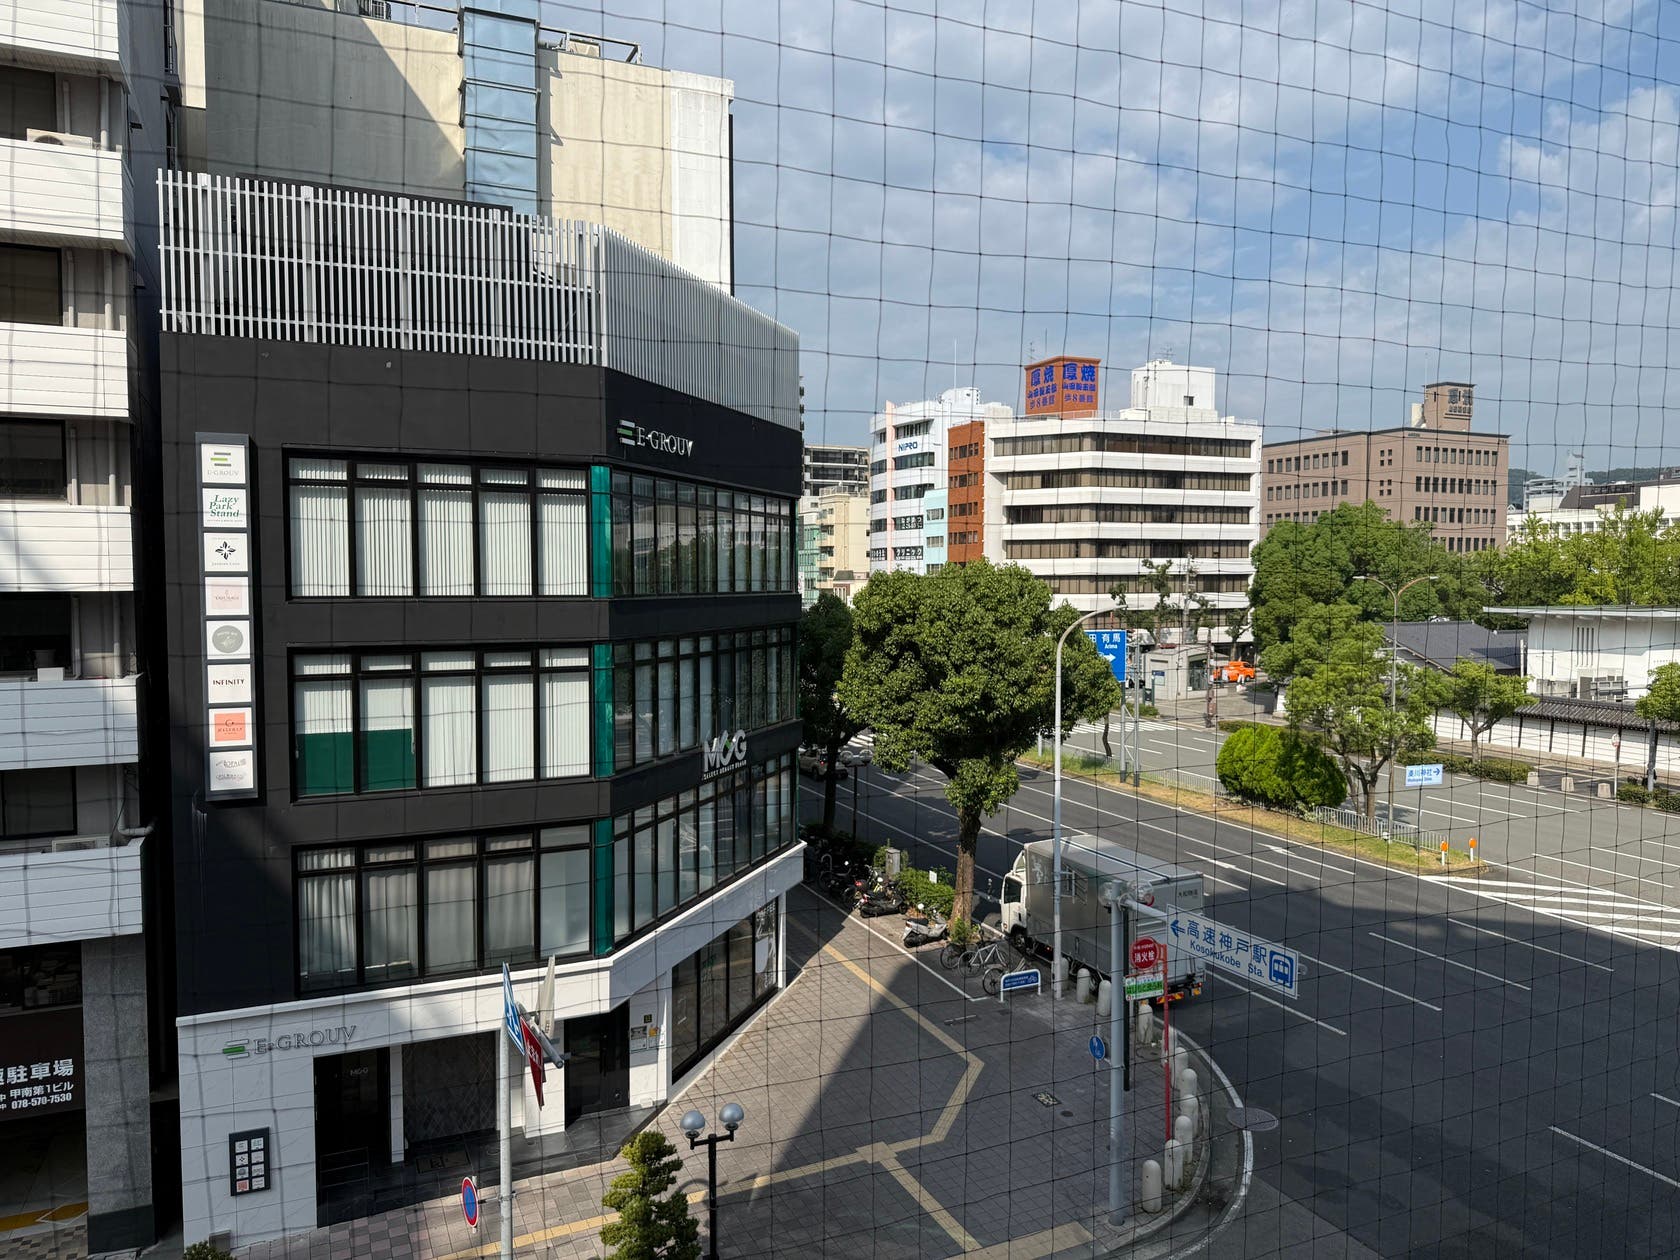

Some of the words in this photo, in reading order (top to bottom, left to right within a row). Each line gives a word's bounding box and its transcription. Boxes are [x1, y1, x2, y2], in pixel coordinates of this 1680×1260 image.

[898, 441, 918, 451] NIPRO
[209, 501, 233, 510] Park
[214, 494, 239, 505] Lazy
[210, 509, 240, 518] Stand
[1101, 633, 1121, 643] 有馬
[704, 729, 747, 773] MOG
[1187, 919, 1267, 966] 高速神戸駅
[1134, 950, 1155, 963] 消火栓
[1190, 940, 1241, 968] Kosokukobe
[1247, 962, 1264, 977] Sta.
[10, 1081, 74, 1099] 甲南第1ビル
[11, 1093, 72, 1109] 078-570-7530
